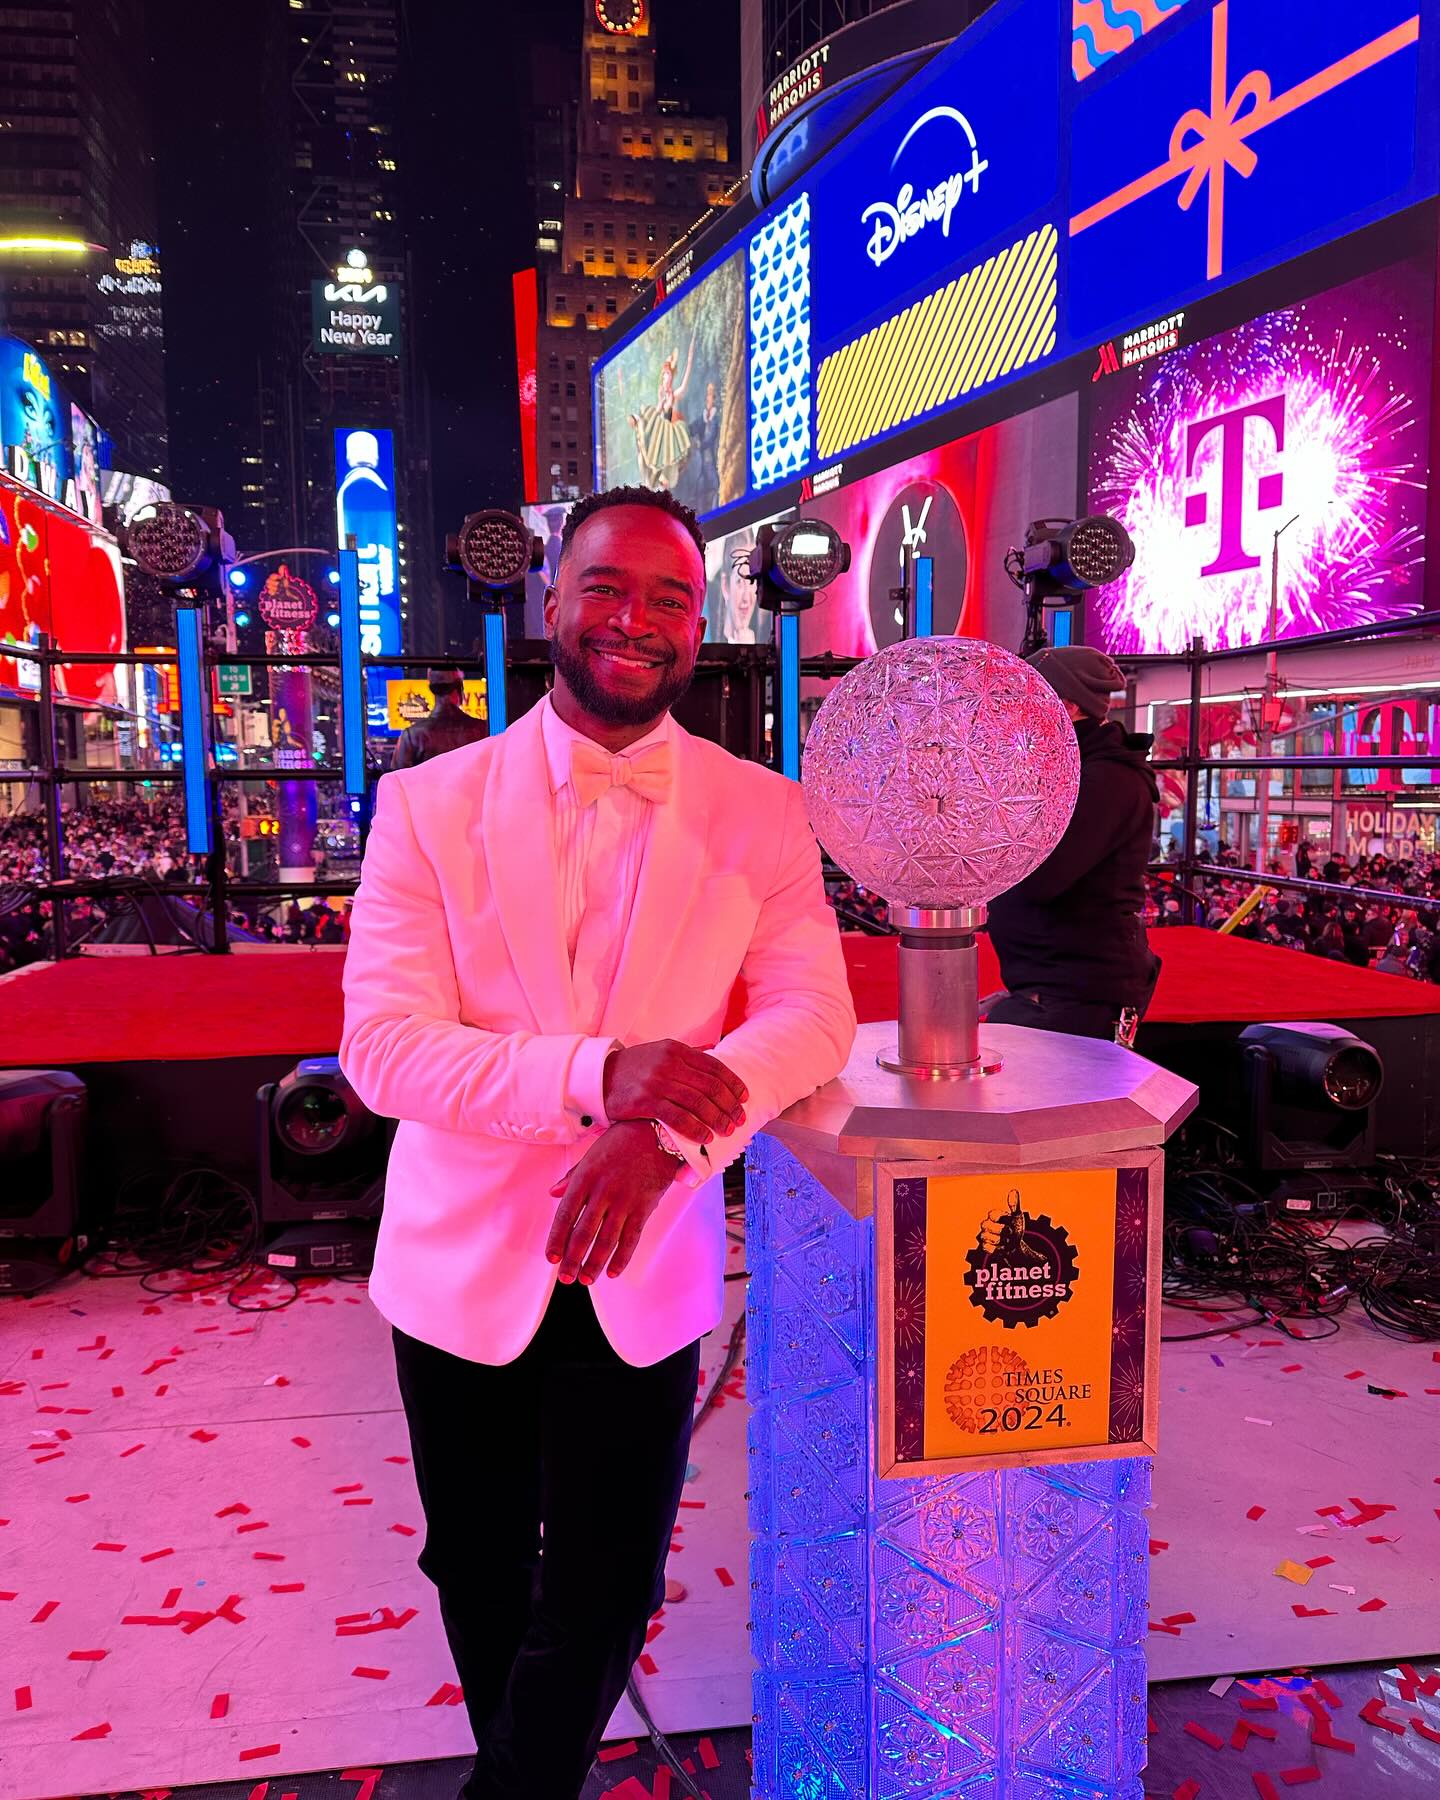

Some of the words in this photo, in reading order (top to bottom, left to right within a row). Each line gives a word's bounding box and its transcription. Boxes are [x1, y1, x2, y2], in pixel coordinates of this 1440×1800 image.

[769, 44, 831, 106] MARRIOTT
[769, 72, 821, 126] MARQUIS
[861, 149, 989, 267] Disney+
[324, 283, 388, 303] KIA
[330, 310, 382, 330] Happy
[1123, 312, 1185, 350] MARRIOTT
[320, 328, 356, 344] New
[358, 329, 393, 345] Year
[1123, 332, 1177, 364] MARQUIS
[1184, 393, 1286, 577] T
[264, 598, 303, 611] planet
[269, 608, 311, 619] fitness
[1345, 810, 1436, 834] HOLIDAY
[975, 1261, 1051, 1288] planet
[985, 1282, 1066, 1301] fitness
[1003, 1369, 1063, 1387] TIMES
[1015, 1384, 1092, 1405] SQUARE
